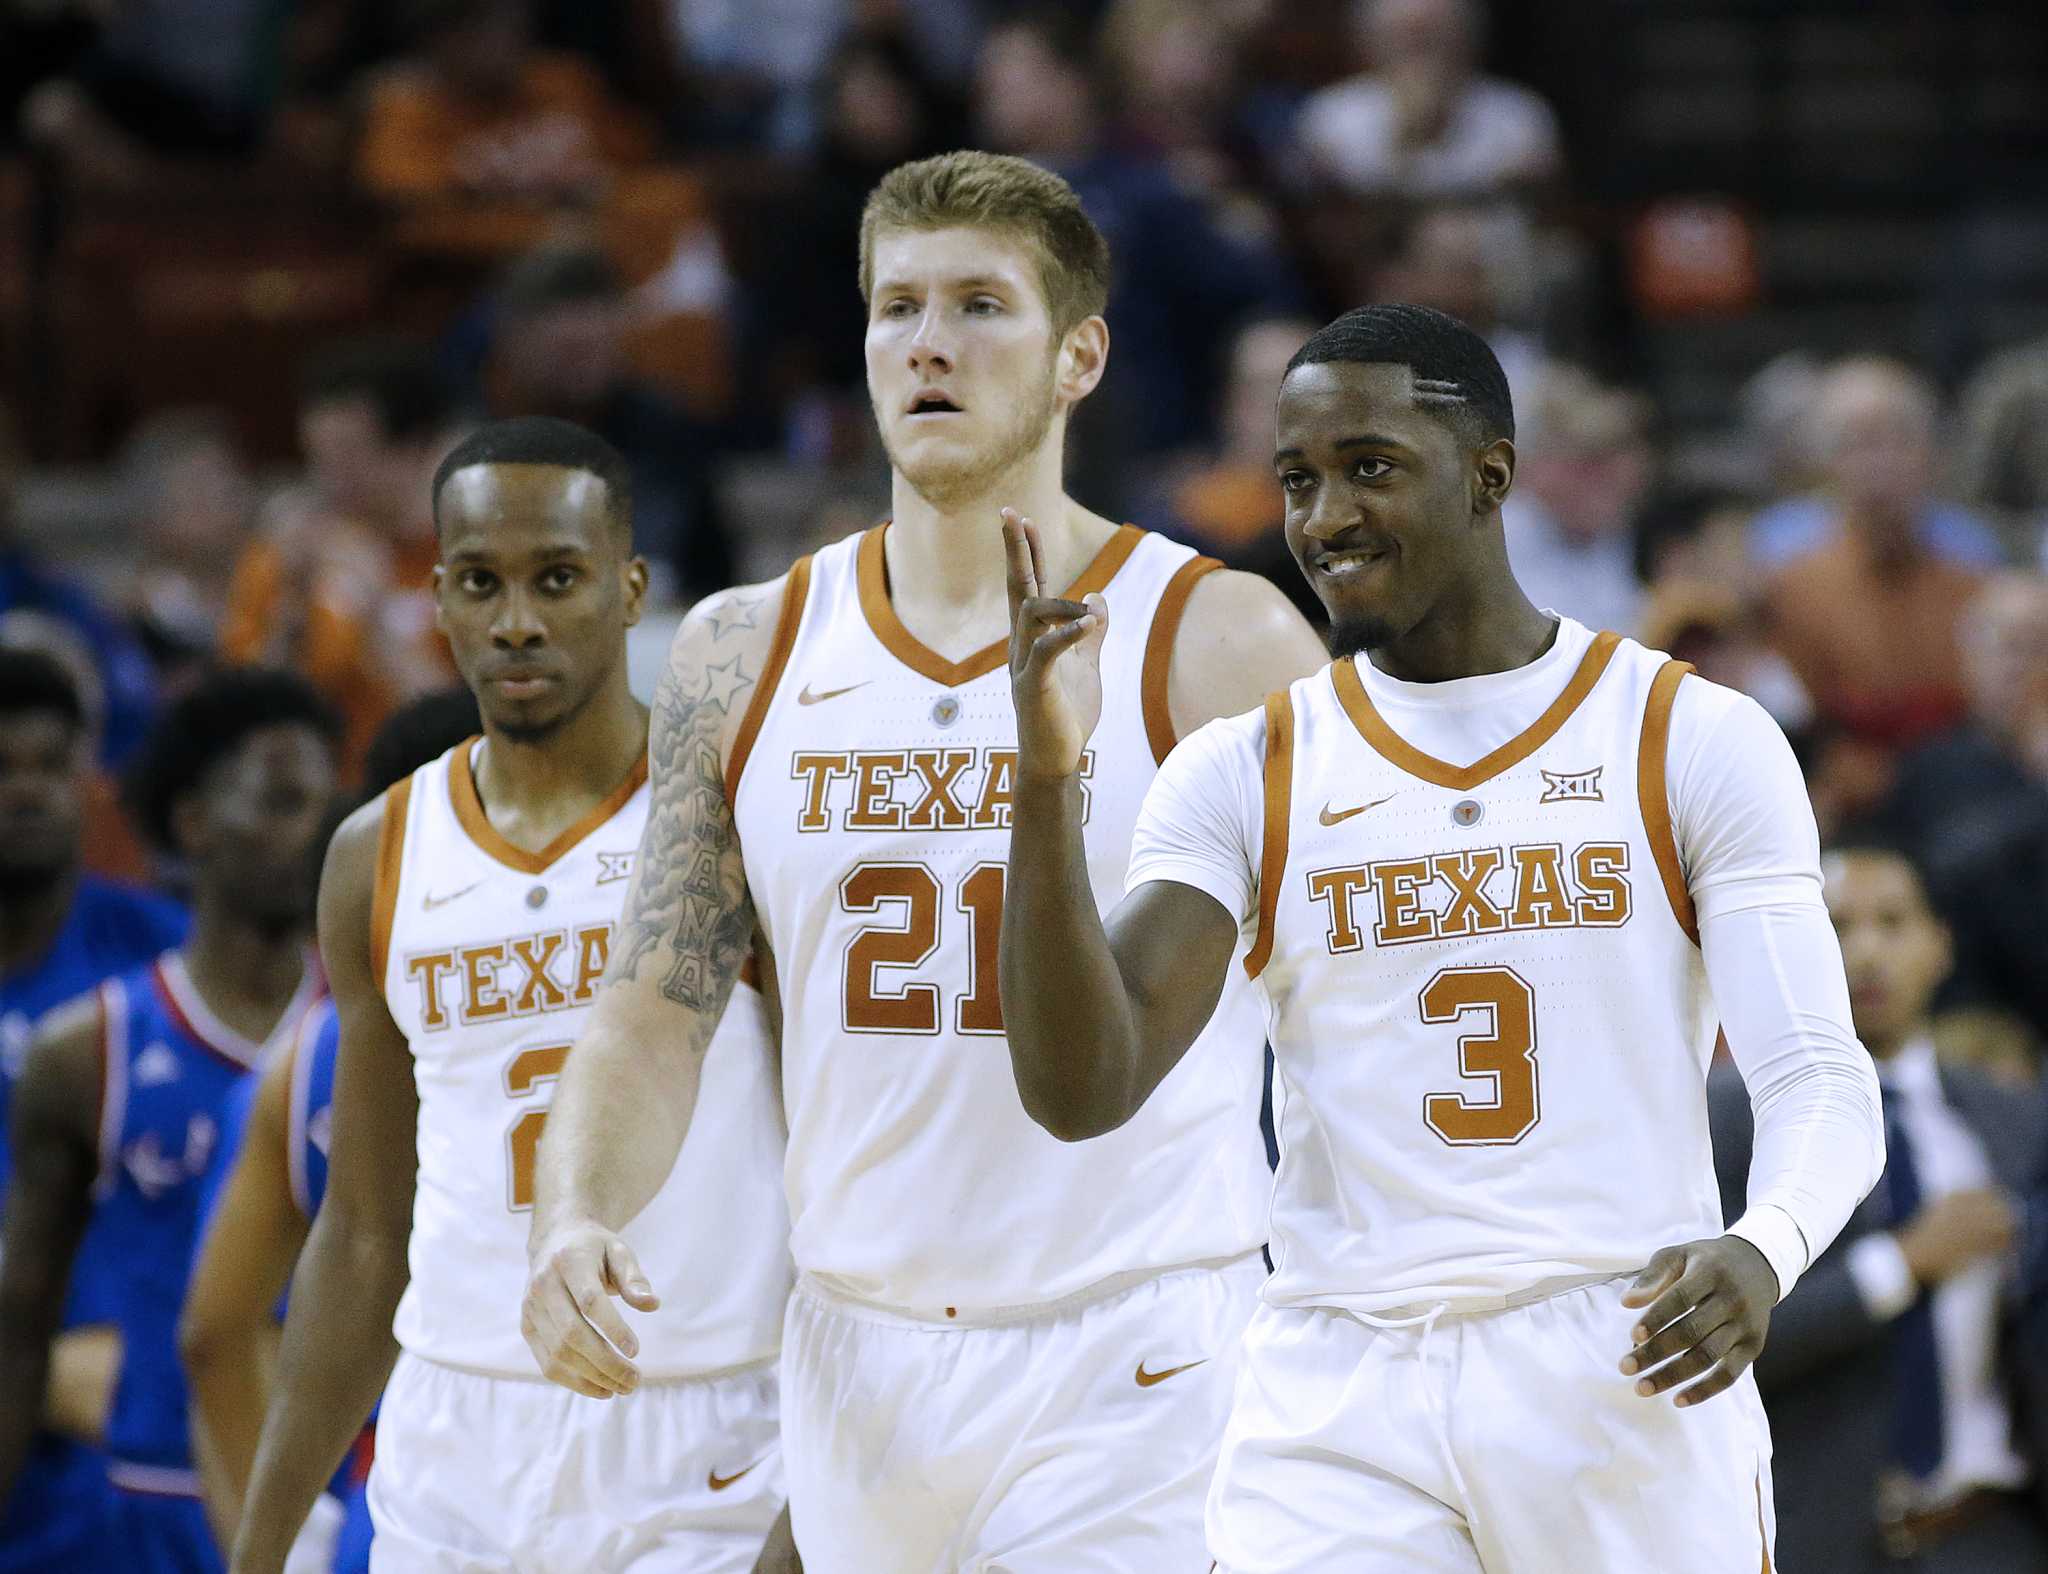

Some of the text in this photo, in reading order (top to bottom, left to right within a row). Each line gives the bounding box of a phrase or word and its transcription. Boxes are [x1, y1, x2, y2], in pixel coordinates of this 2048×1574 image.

[790, 746, 1096, 832] TEXA
[1539, 765, 1604, 804] XII
[838, 861, 1009, 1036] 21
[1306, 841, 1633, 955] TEXAS
[404, 920, 616, 1033] TEXA
[1418, 964, 1541, 1147] 3
